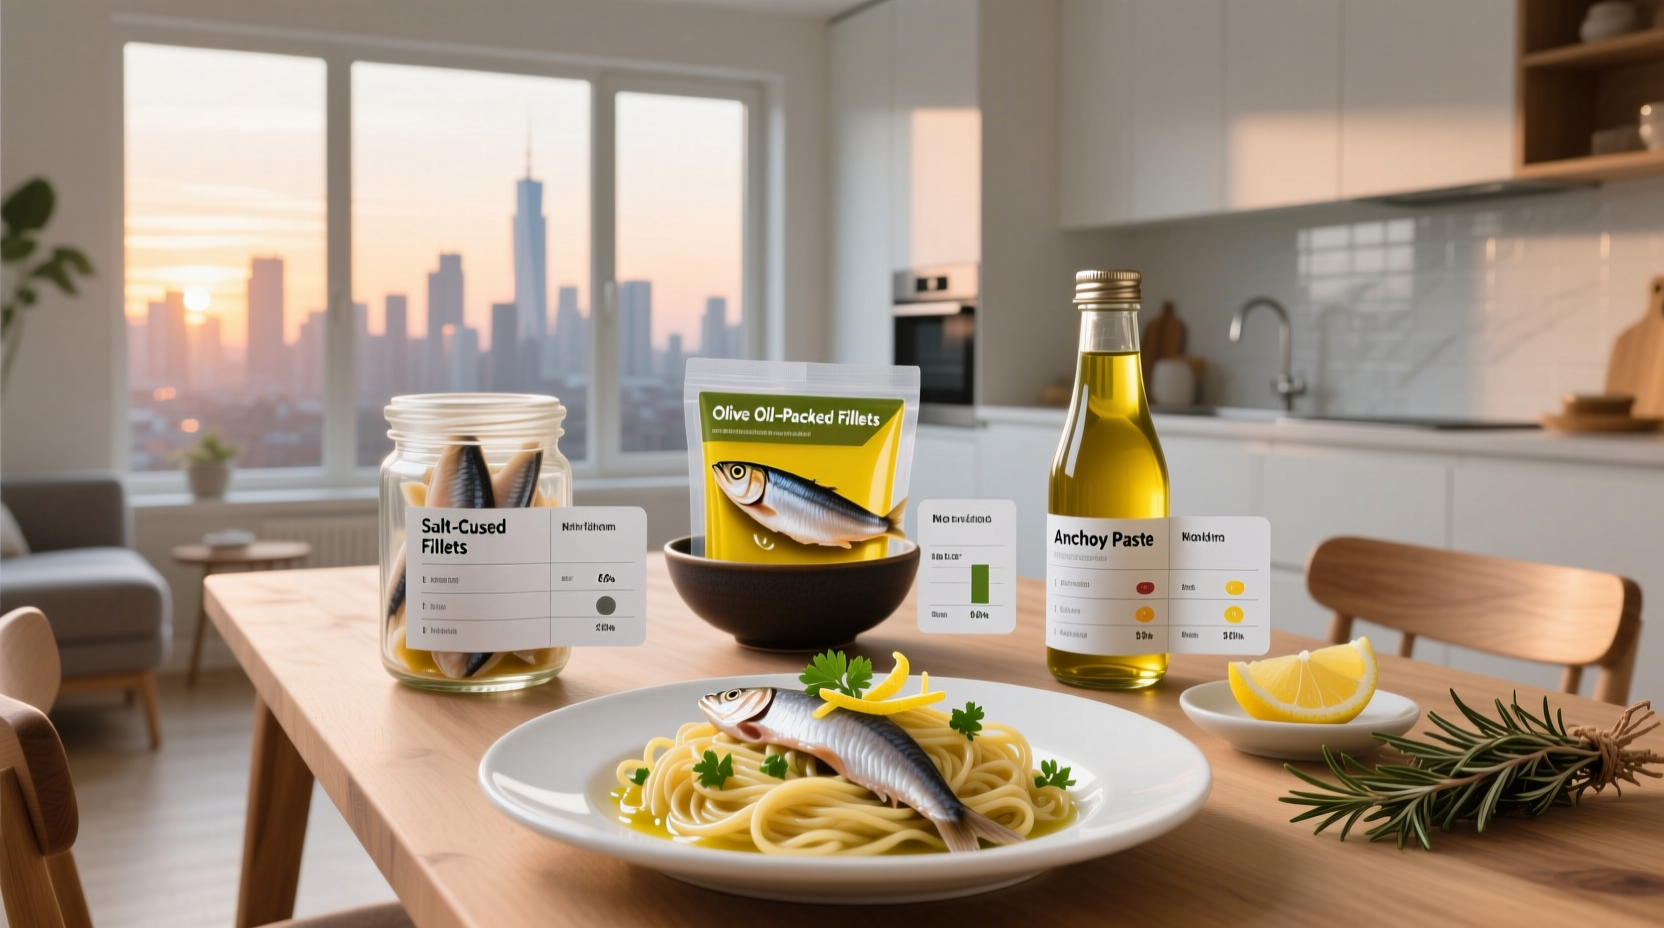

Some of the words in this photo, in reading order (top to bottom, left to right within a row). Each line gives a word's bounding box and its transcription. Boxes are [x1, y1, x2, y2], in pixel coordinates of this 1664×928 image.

[712, 405, 750, 421] Olive
[838, 409, 880, 426] Fillets
[421, 517, 507, 535] Salt-Cused
[421, 538, 468, 555] Fillets
[1054, 529, 1108, 550] Anchoy
[1112, 531, 1154, 547] Paste
